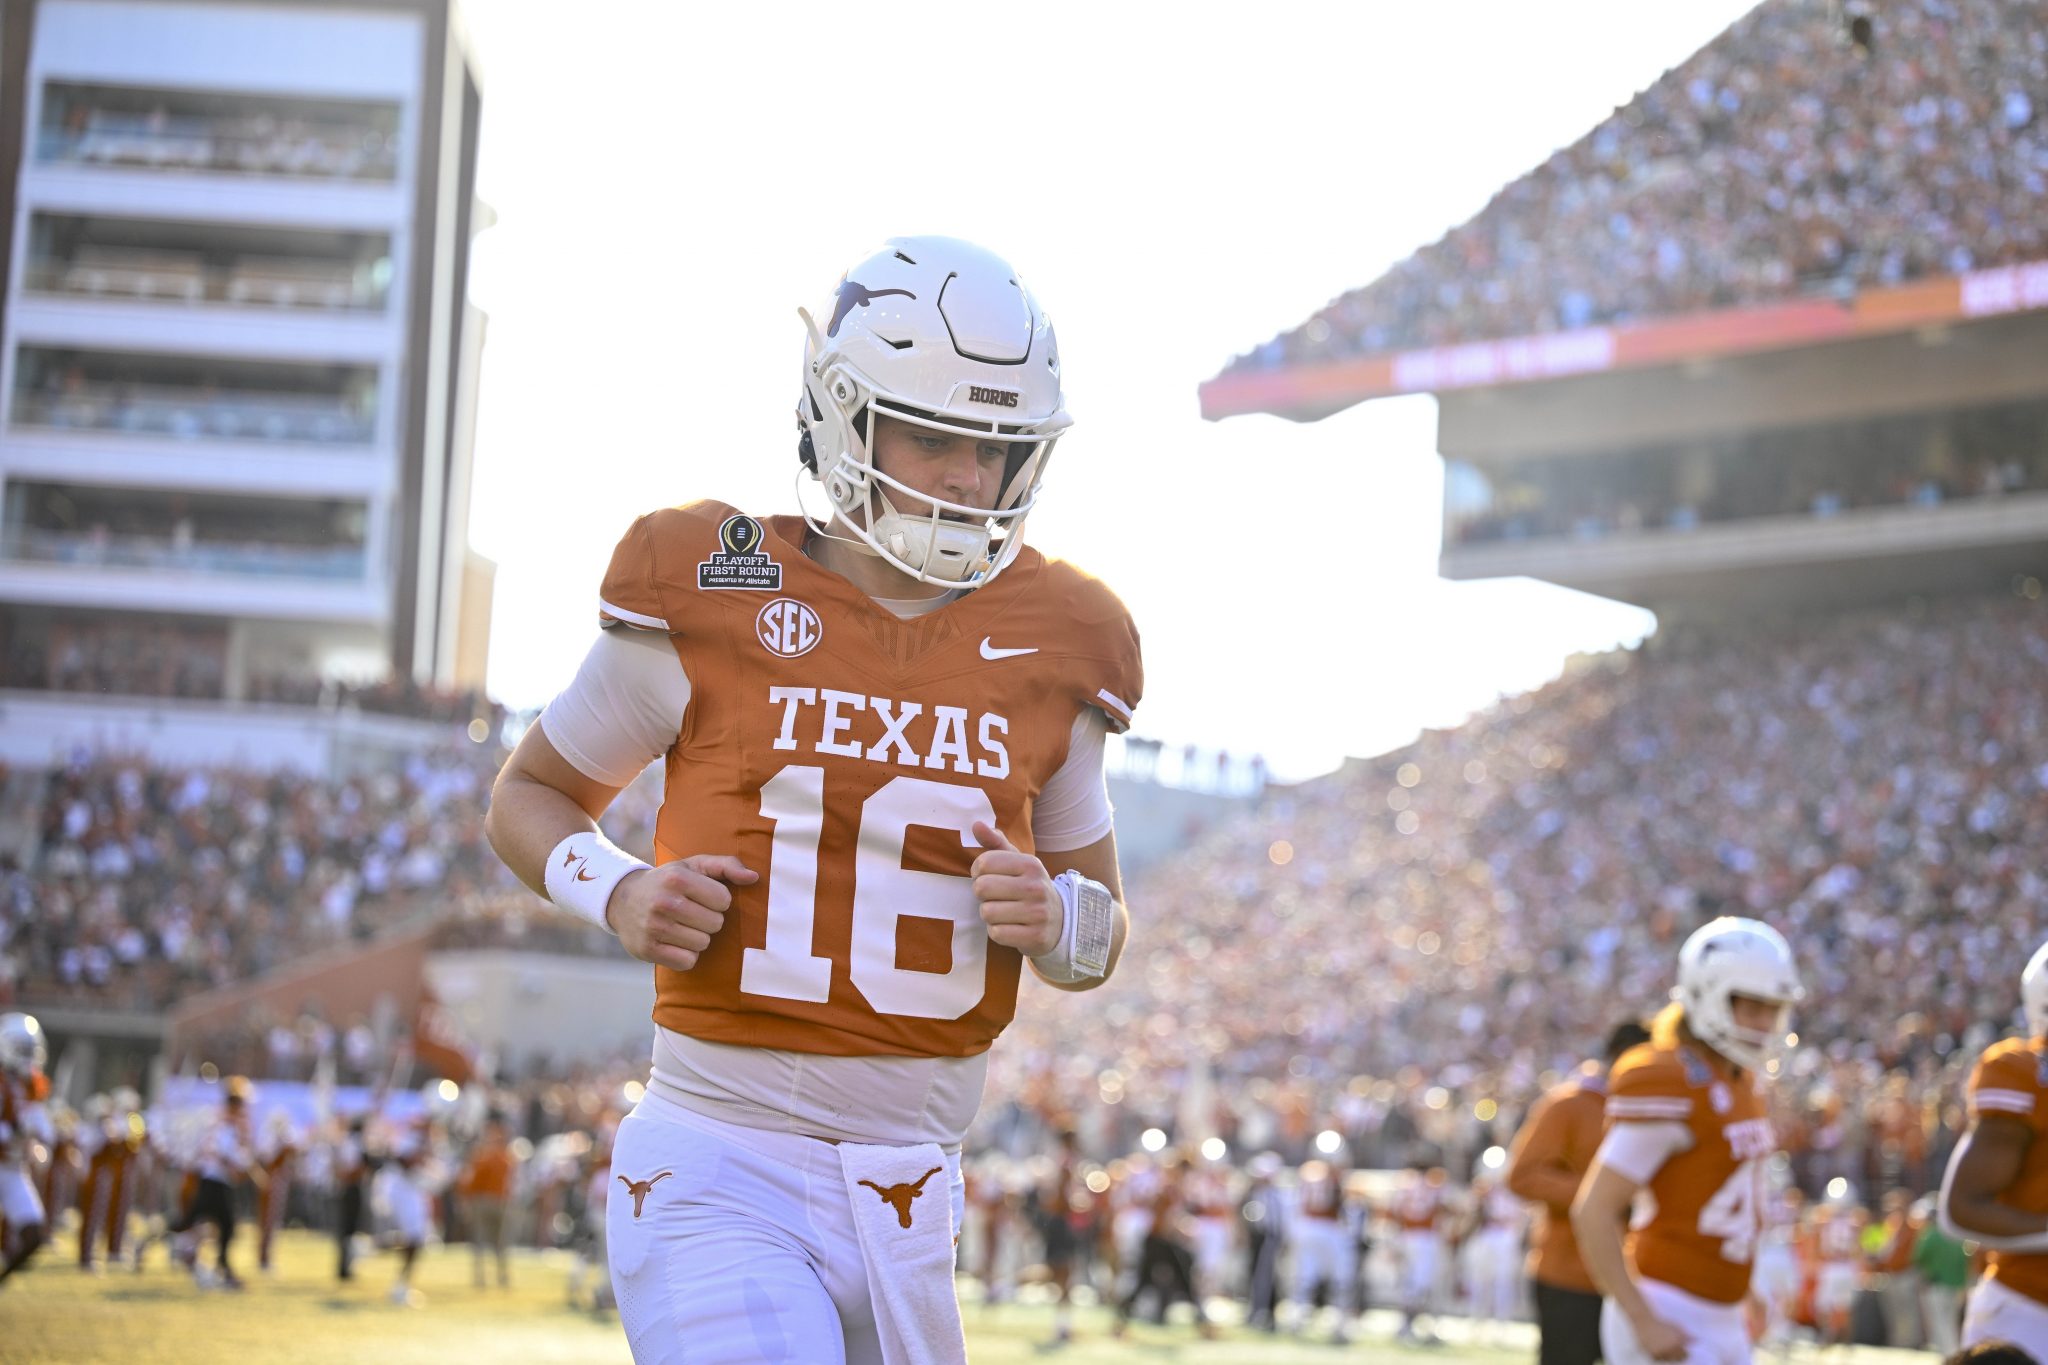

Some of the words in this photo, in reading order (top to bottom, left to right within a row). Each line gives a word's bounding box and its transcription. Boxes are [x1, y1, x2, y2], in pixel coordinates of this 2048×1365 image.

[969, 386, 1018, 408] HORNS
[703, 566, 736, 575] FIRST
[738, 566, 777, 576] ROUND
[715, 556, 765, 565] PLAYOFF
[763, 602, 816, 653] SEC
[769, 686, 1010, 779] TEXAS
[740, 764, 996, 1020] 16
